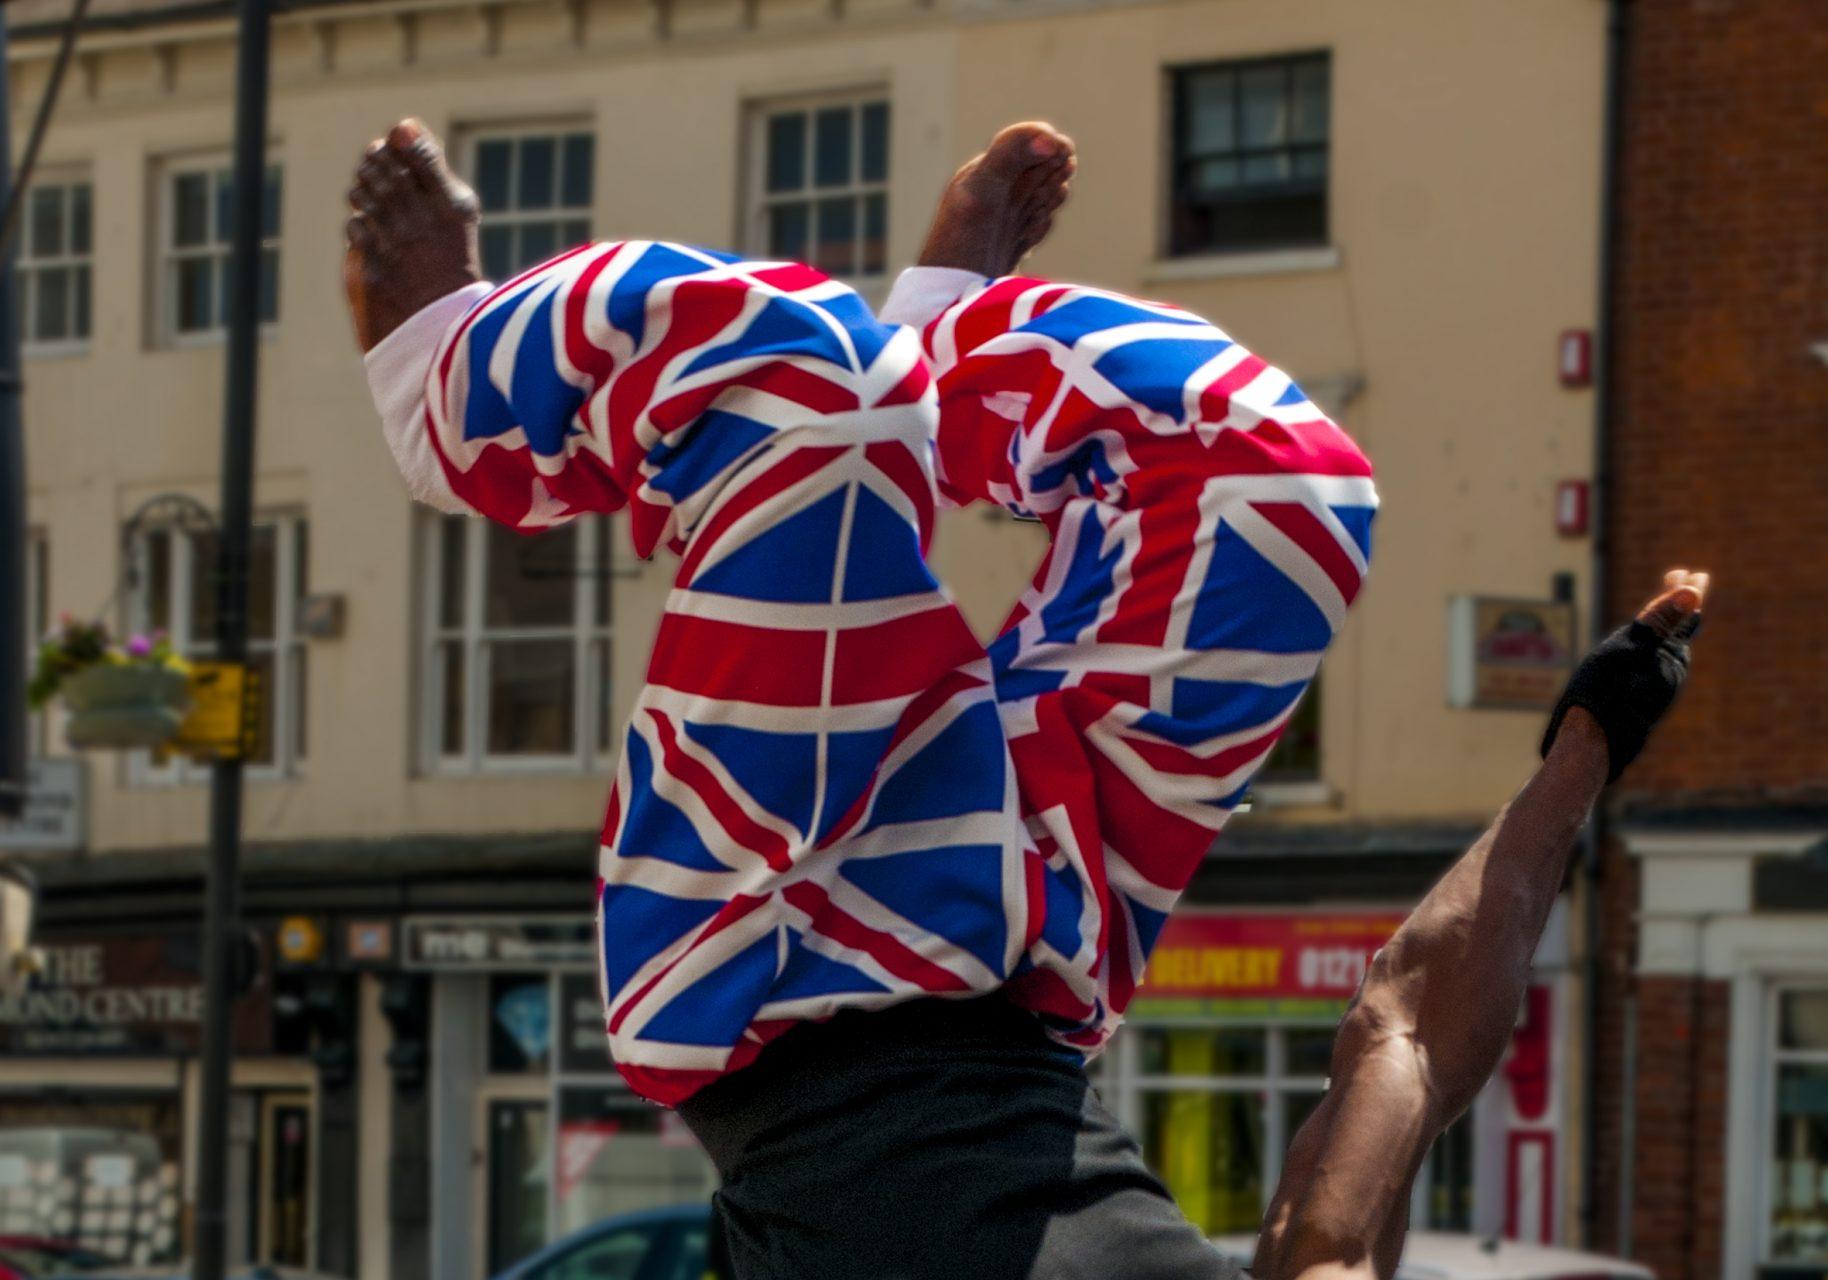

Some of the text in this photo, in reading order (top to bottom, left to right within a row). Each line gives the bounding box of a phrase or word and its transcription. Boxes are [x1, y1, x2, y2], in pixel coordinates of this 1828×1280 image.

[31, 945, 102, 985] THE
[1152, 948, 1283, 986] DELIVERY
[84, 985, 206, 1022] CENTRE
